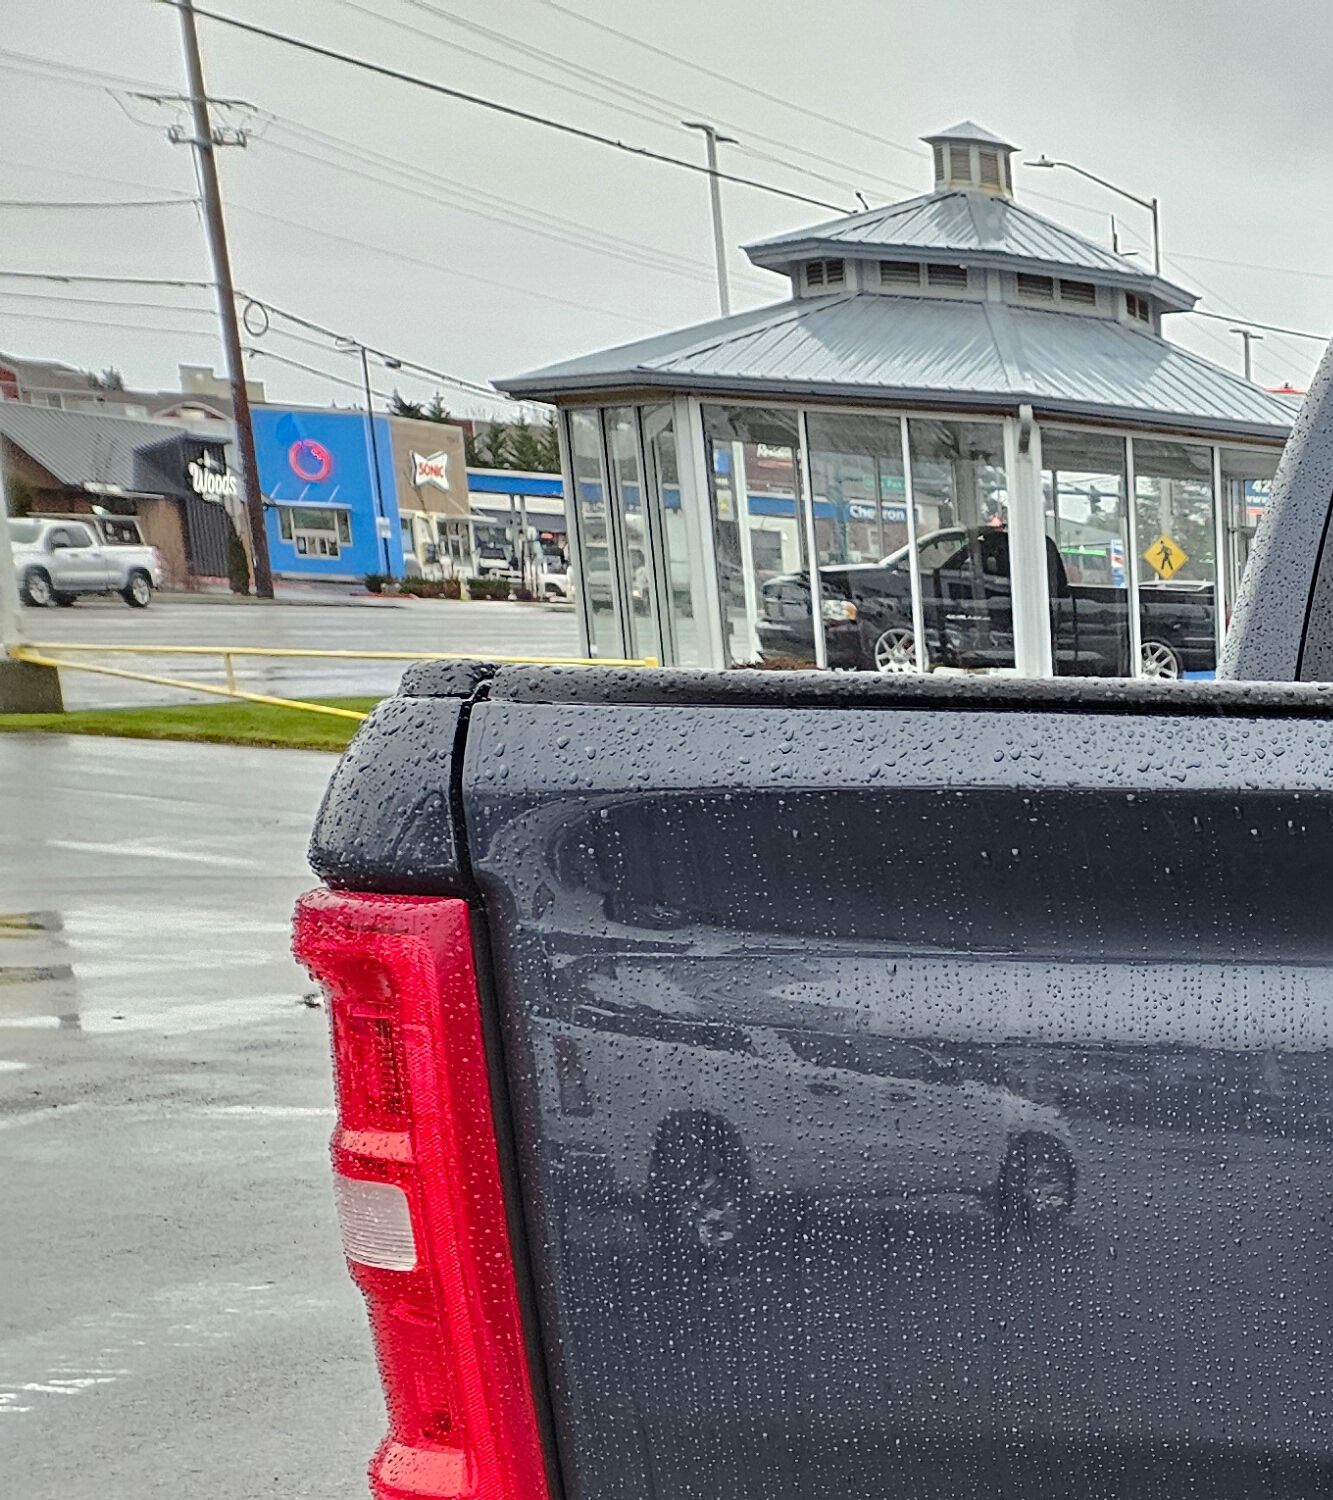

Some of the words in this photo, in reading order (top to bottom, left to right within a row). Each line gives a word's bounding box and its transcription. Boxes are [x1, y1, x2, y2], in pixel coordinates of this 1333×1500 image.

[188, 461, 237, 495] Woods
[419, 462, 444, 478] SONIC
[850, 505, 906, 521] Cheron
